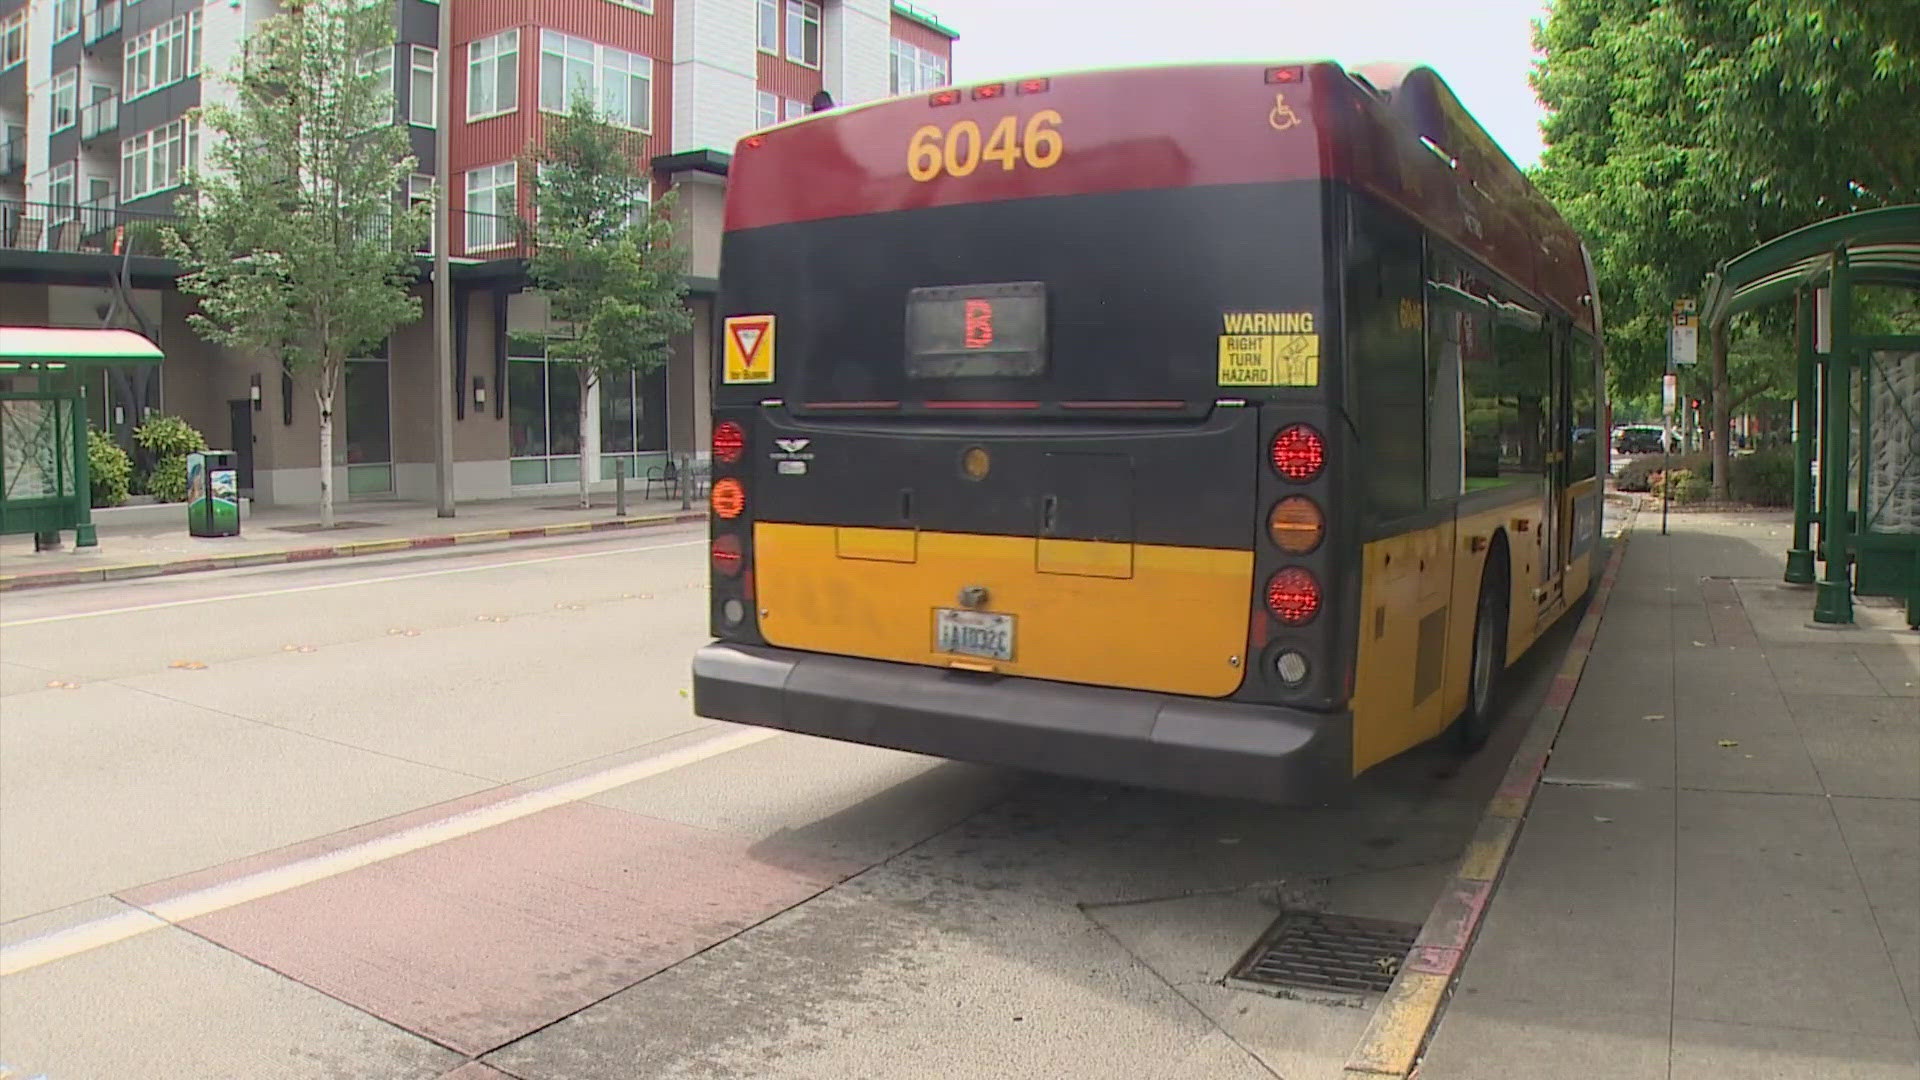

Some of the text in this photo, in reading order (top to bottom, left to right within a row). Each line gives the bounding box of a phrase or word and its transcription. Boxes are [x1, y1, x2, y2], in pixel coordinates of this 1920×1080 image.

[907, 109, 1064, 183] 6046
[964, 298, 993, 349] B
[1223, 312, 1313, 333] WARNING
[1227, 337, 1264, 351] RIGHT
[1229, 353, 1261, 366] TURN
[1222, 369, 1268, 382] HAZARD
